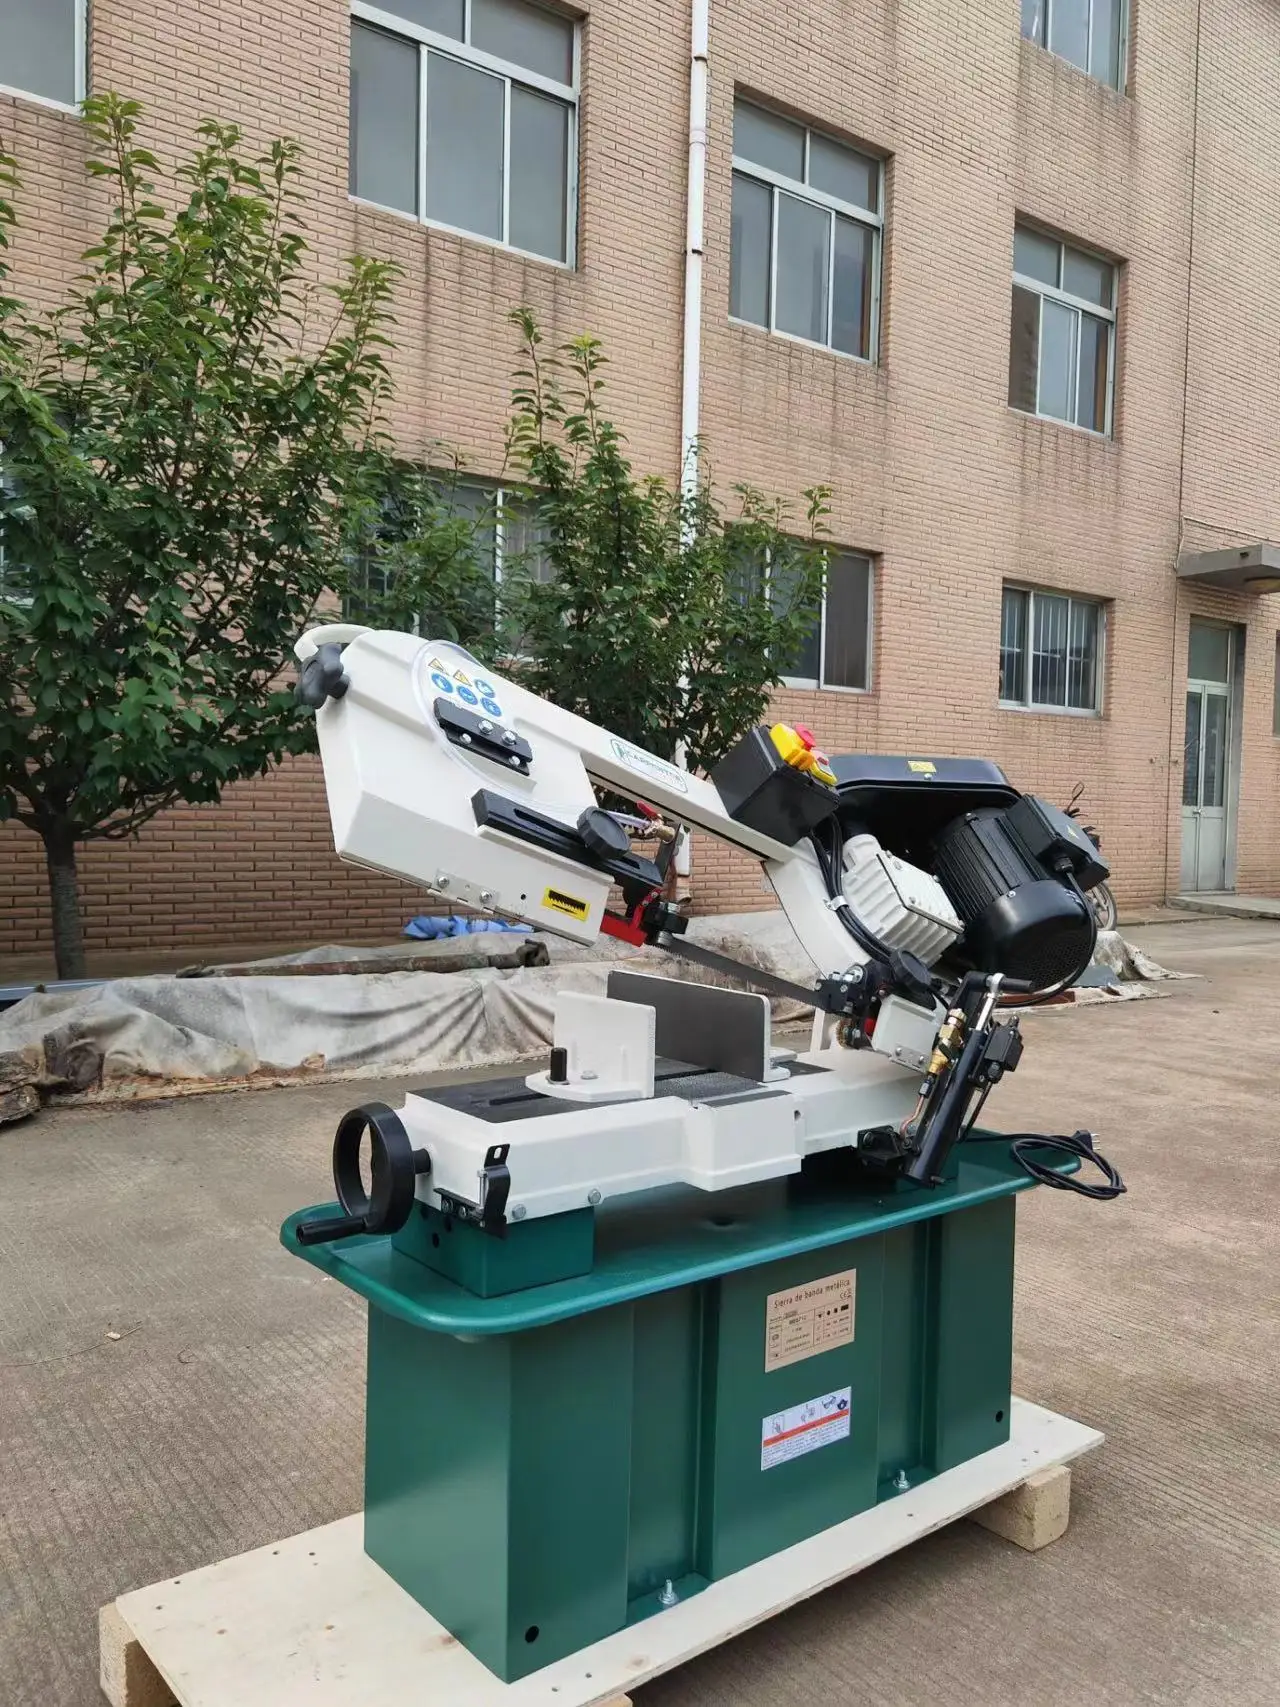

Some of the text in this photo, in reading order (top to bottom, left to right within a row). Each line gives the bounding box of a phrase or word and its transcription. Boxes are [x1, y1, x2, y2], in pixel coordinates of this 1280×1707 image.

[774, 1279, 850, 1309] Sierra de banda metálica
